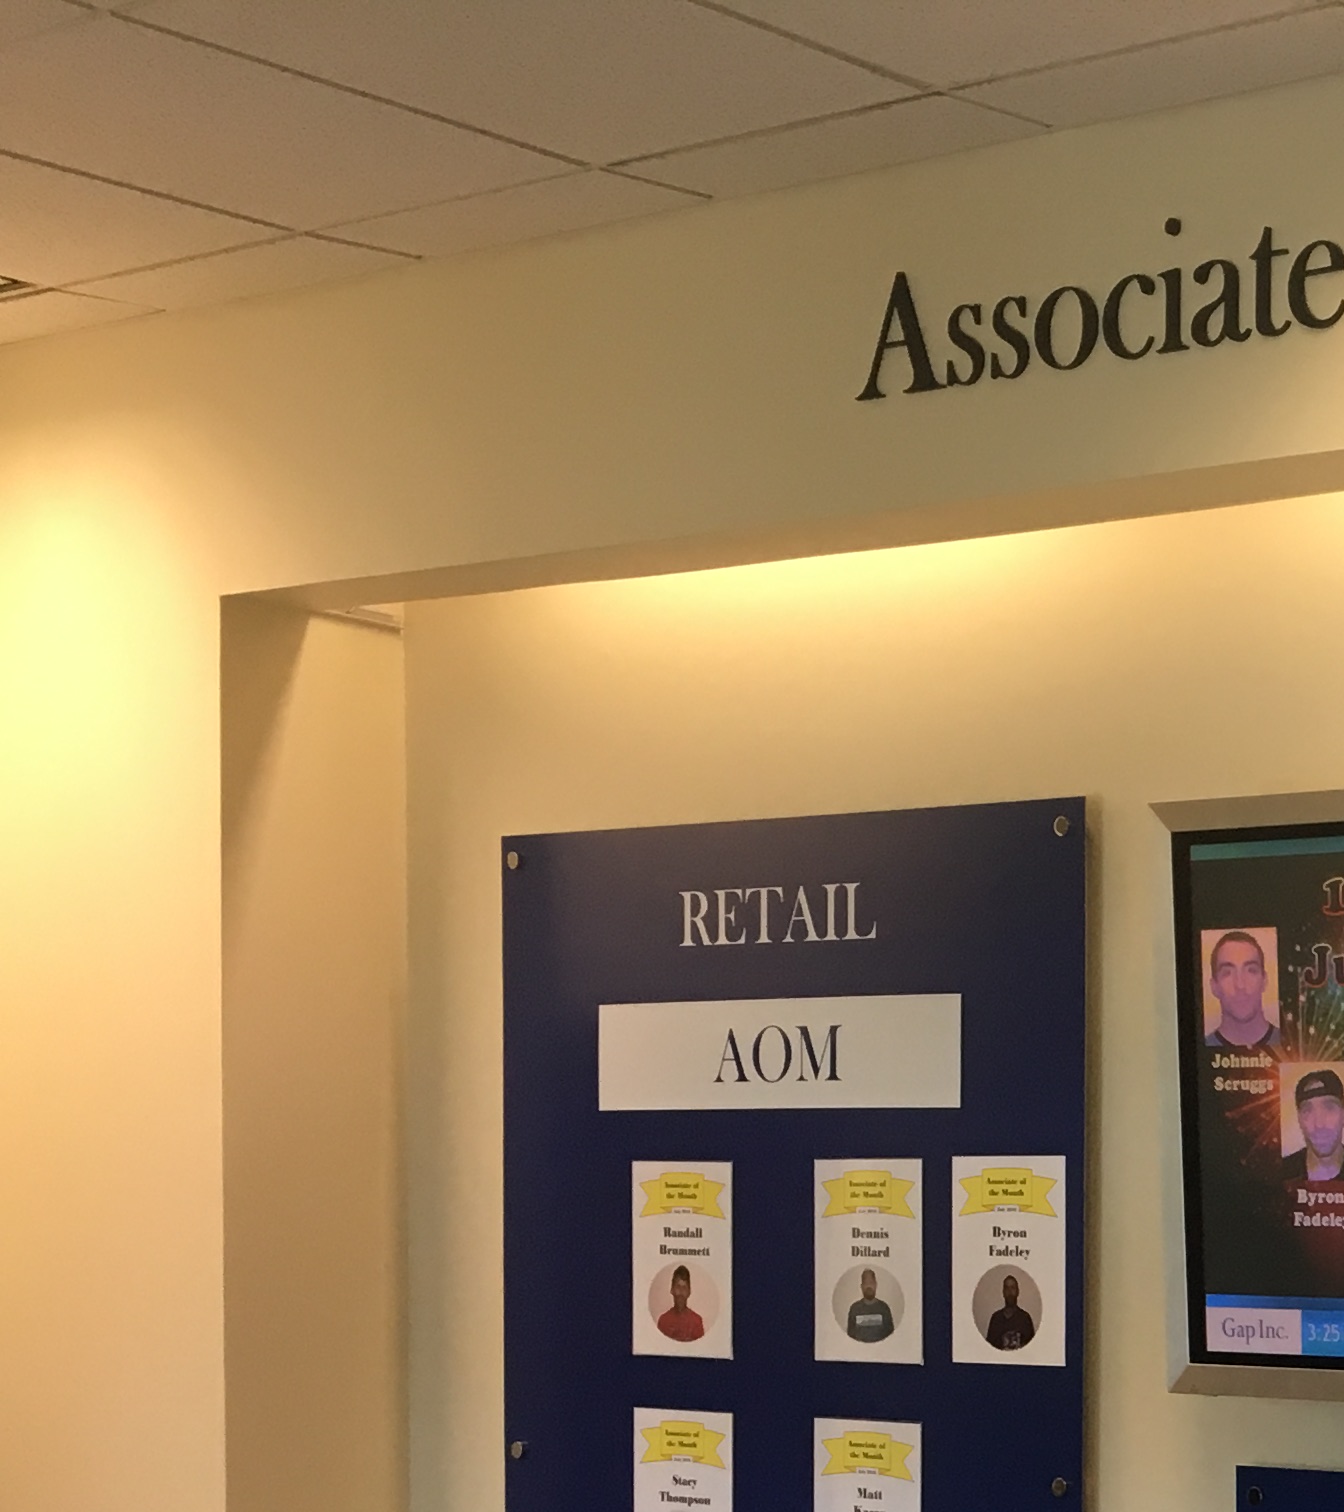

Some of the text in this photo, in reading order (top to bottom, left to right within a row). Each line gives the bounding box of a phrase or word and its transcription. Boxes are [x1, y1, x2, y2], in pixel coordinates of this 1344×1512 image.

[679, 882, 877, 947] RETAIL
[713, 1024, 842, 1083] AOM
[1211, 1053, 1273, 1069] Johnnie
[1214, 1076, 1273, 1093] Scruggs
[1297, 1189, 1344, 1206] Byron
[663, 1227, 703, 1239] Randall
[851, 1227, 890, 1240] Dennis
[992, 1226, 1027, 1241] Byron
[659, 1245, 711, 1257] Brummett
[850, 1245, 890, 1258] Dillard
[988, 1245, 1031, 1261] Fadeley
[1221, 1317, 1289, 1344] Gap Inc.
[1307, 1323, 1341, 1342] 3:25
[672, 1475, 698, 1490] Stacy
[659, 1491, 711, 1507] Thompson
[857, 1487, 882, 1501] Matt
